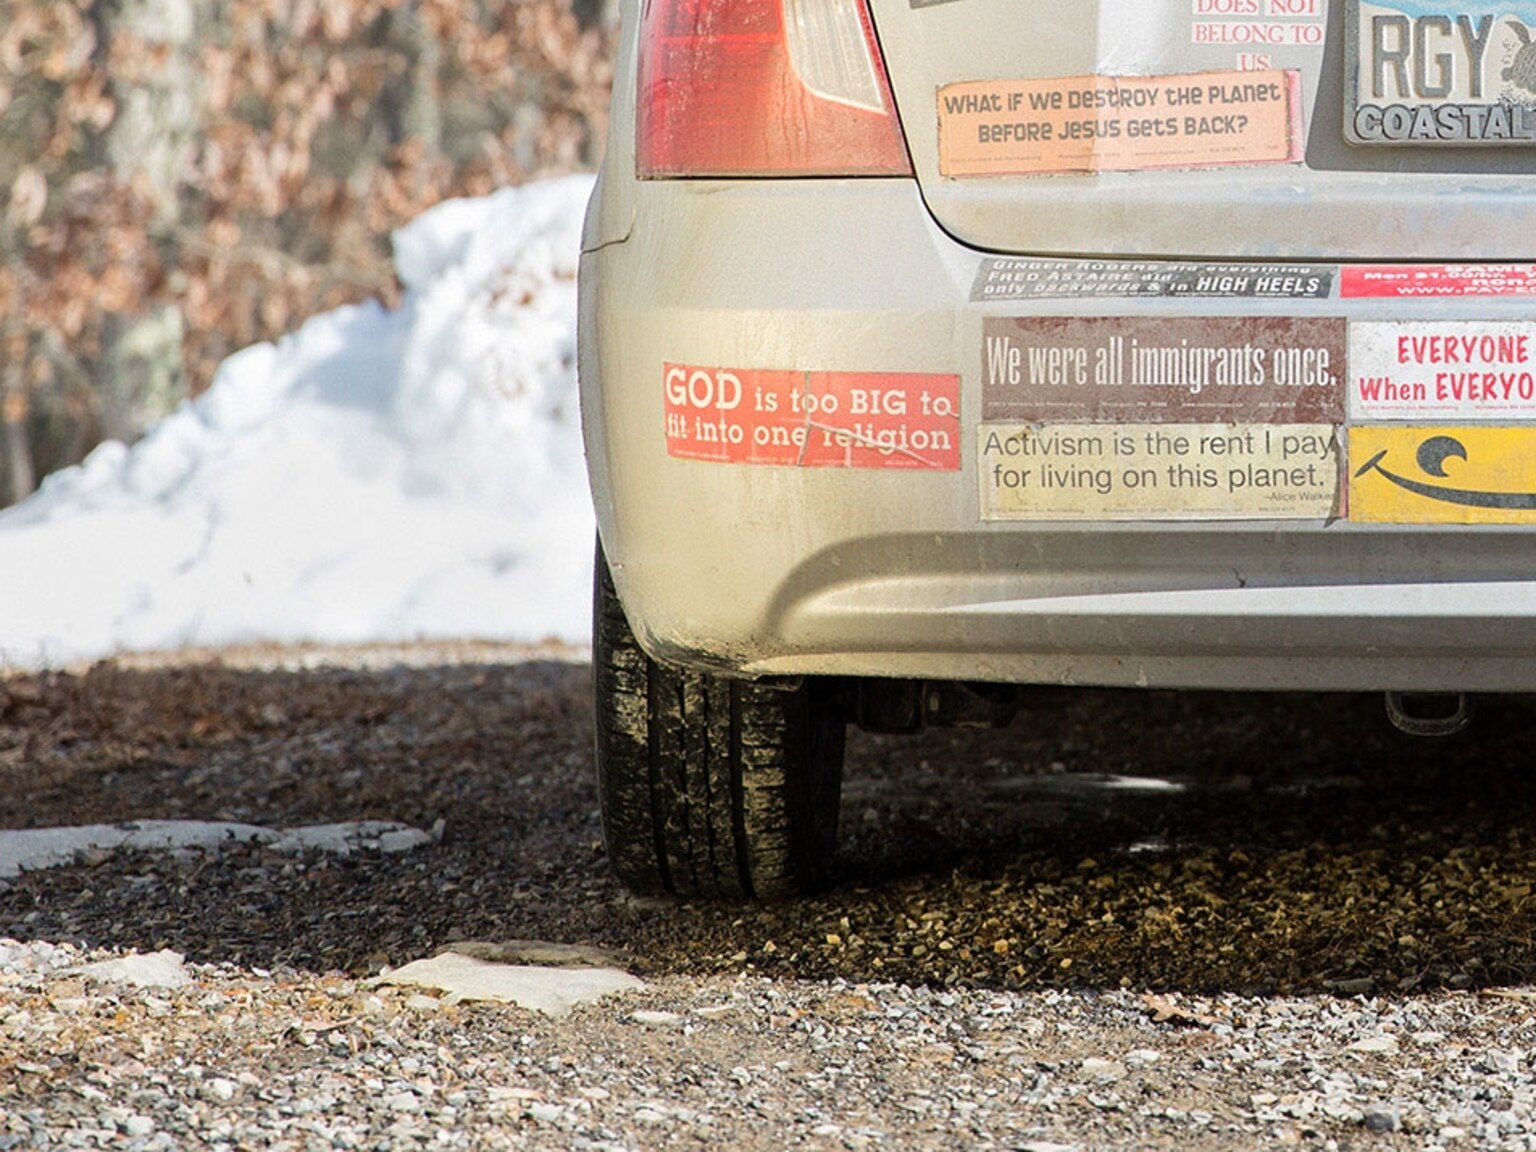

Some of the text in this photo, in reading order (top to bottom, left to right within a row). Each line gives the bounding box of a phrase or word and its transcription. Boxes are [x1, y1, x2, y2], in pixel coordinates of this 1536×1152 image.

[1196, 24, 1322, 43] BELONG TO
[1372, 14, 1496, 99] RGY
[1355, 105, 1535, 141] COASTAL
[986, 336, 1337, 393] We were all immigrants once.
[1397, 335, 1529, 364] EVERYONE
[665, 368, 951, 415] GOD is too BIG to
[1359, 377, 1426, 401] When
[667, 413, 951, 454] fit into one religion
[983, 432, 1103, 456] Activism
[1114, 433, 1135, 455] is
[1145, 432, 1190, 455] the
[1200, 433, 1254, 455] rent
[1283, 435, 1335, 460] pay
[994, 465, 1324, 493] for living on this planet.
